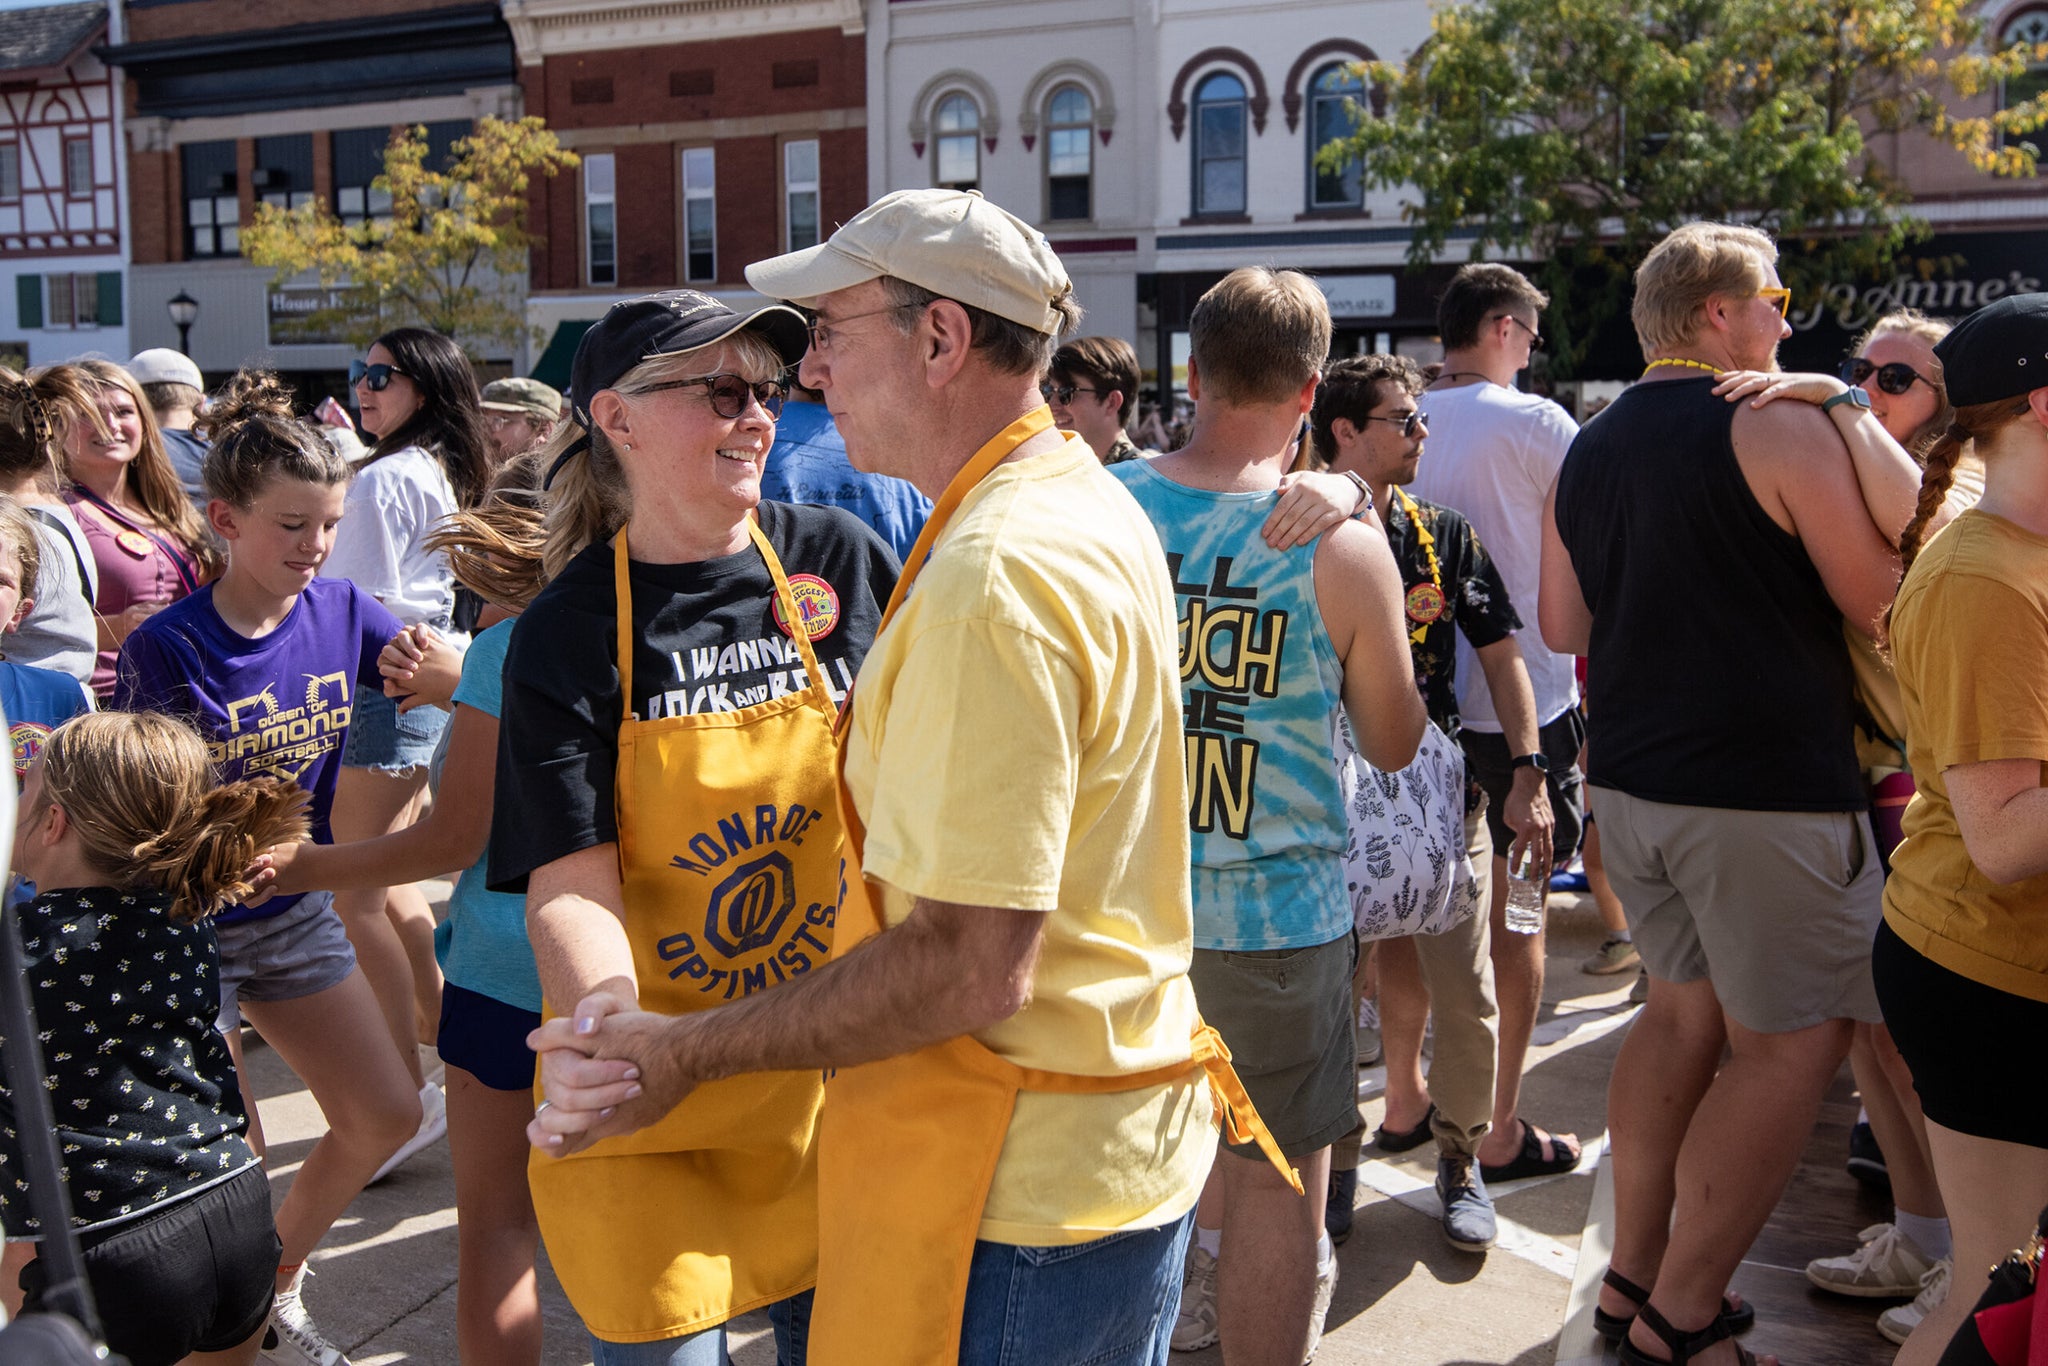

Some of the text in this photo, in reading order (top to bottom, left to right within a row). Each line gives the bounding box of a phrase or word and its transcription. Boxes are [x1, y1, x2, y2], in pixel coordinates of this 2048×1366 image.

[672, 636, 804, 682] I WANNA
[257, 699, 329, 729] QUEEN OF
[734, 684, 769, 708] AND
[206, 705, 353, 764] DIAMOND
[249, 736, 335, 770] SOFTBALL
[668, 803, 823, 877] MONROE
[656, 902, 836, 1000] OPTIMISTS
